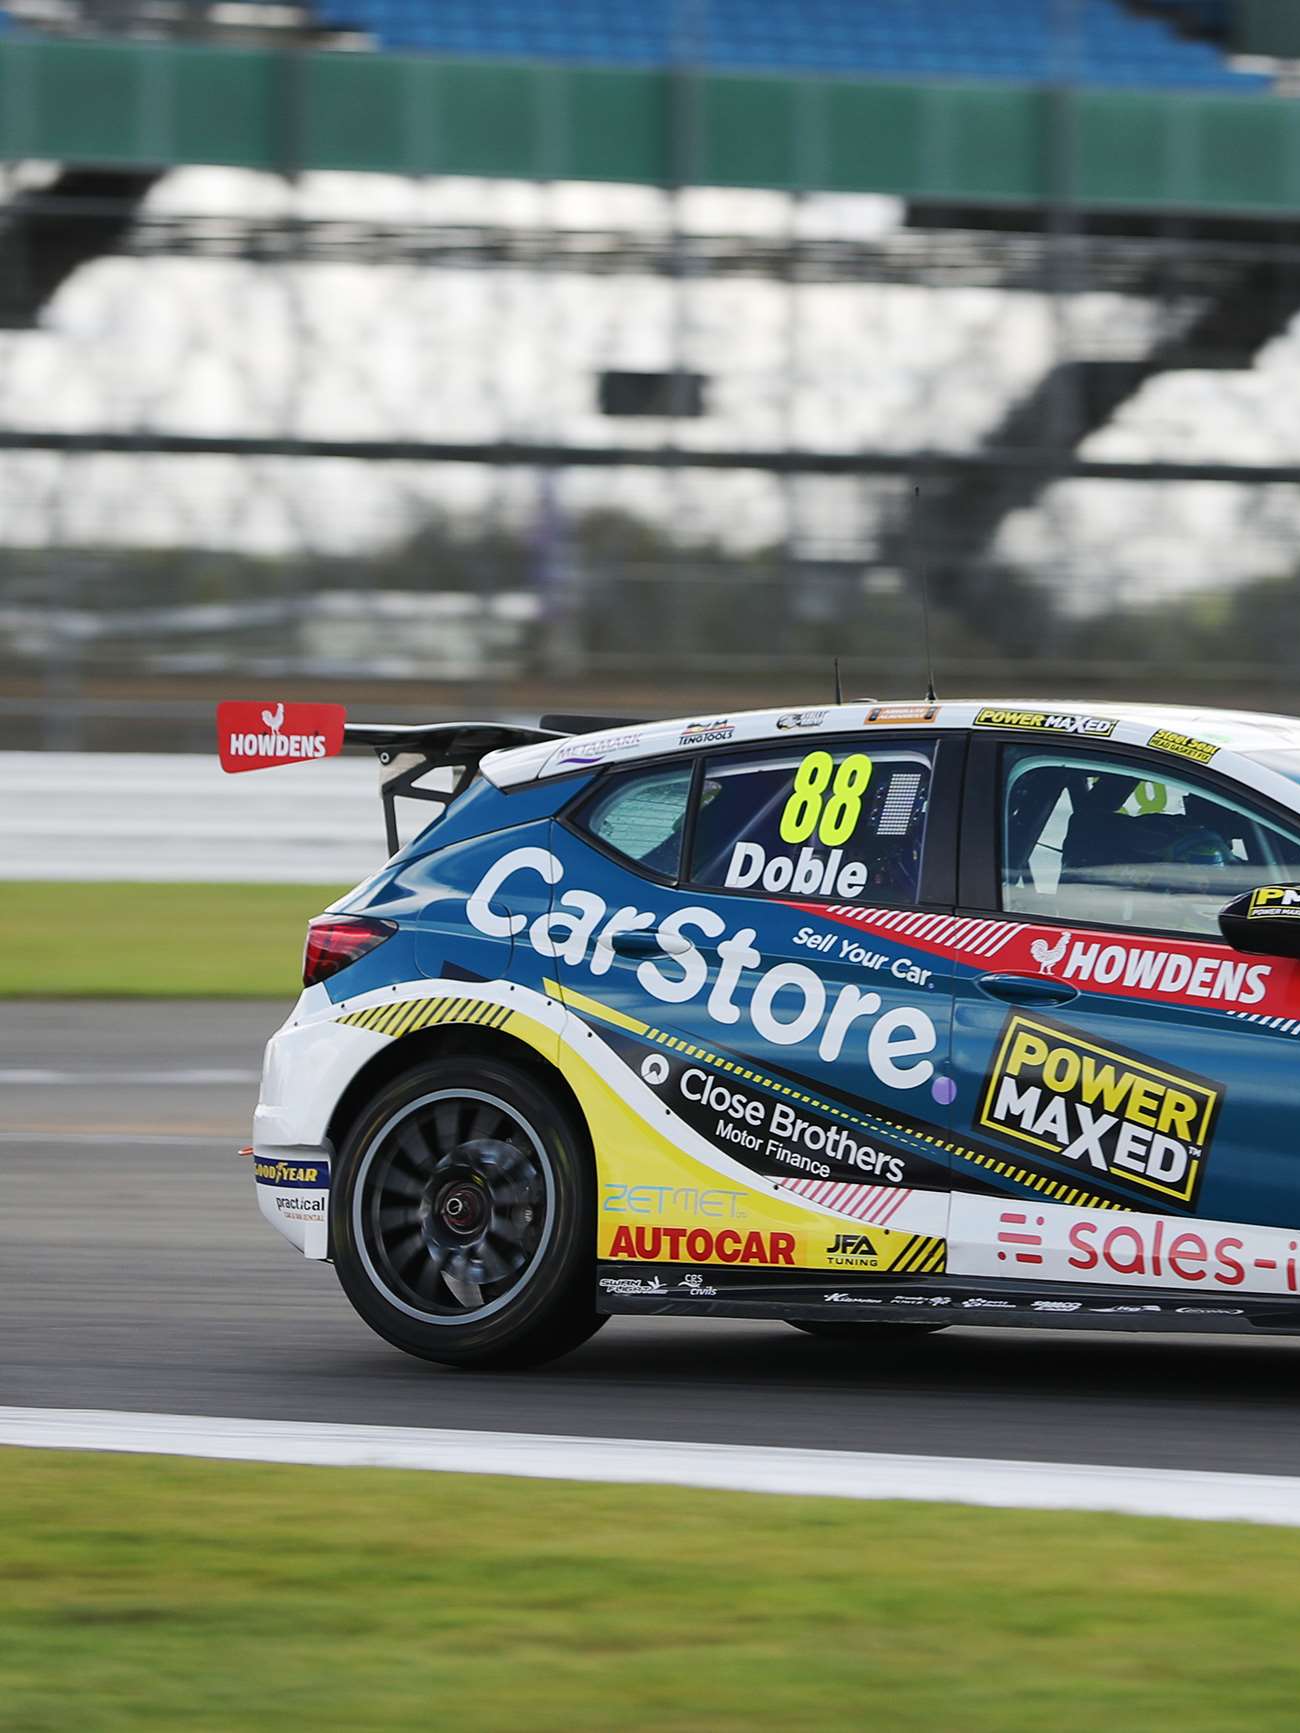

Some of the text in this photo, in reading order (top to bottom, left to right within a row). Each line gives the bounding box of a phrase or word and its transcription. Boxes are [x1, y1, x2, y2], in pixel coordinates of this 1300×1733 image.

[229, 733, 326, 758] HOWDENS
[979, 709, 1112, 734] POWER MAXED
[779, 750, 873, 847] 88
[724, 841, 869, 898] Doble
[791, 926, 839, 953] Sell
[838, 939, 890, 971] Your
[1062, 939, 1272, 1005] HOWDENS
[1004, 1031, 1198, 1142] POWER
[679, 1067, 906, 1184] Close Brothers
[715, 1118, 831, 1179] Motor Finance
[993, 1075, 1189, 1184] MAXED
[275, 1196, 325, 1212] practical
[607, 1224, 796, 1266] AUTOCAR
[826, 1234, 879, 1256] JFA
[826, 1256, 879, 1267] TUNING
[1066, 1219, 1300, 1292] sales-i
